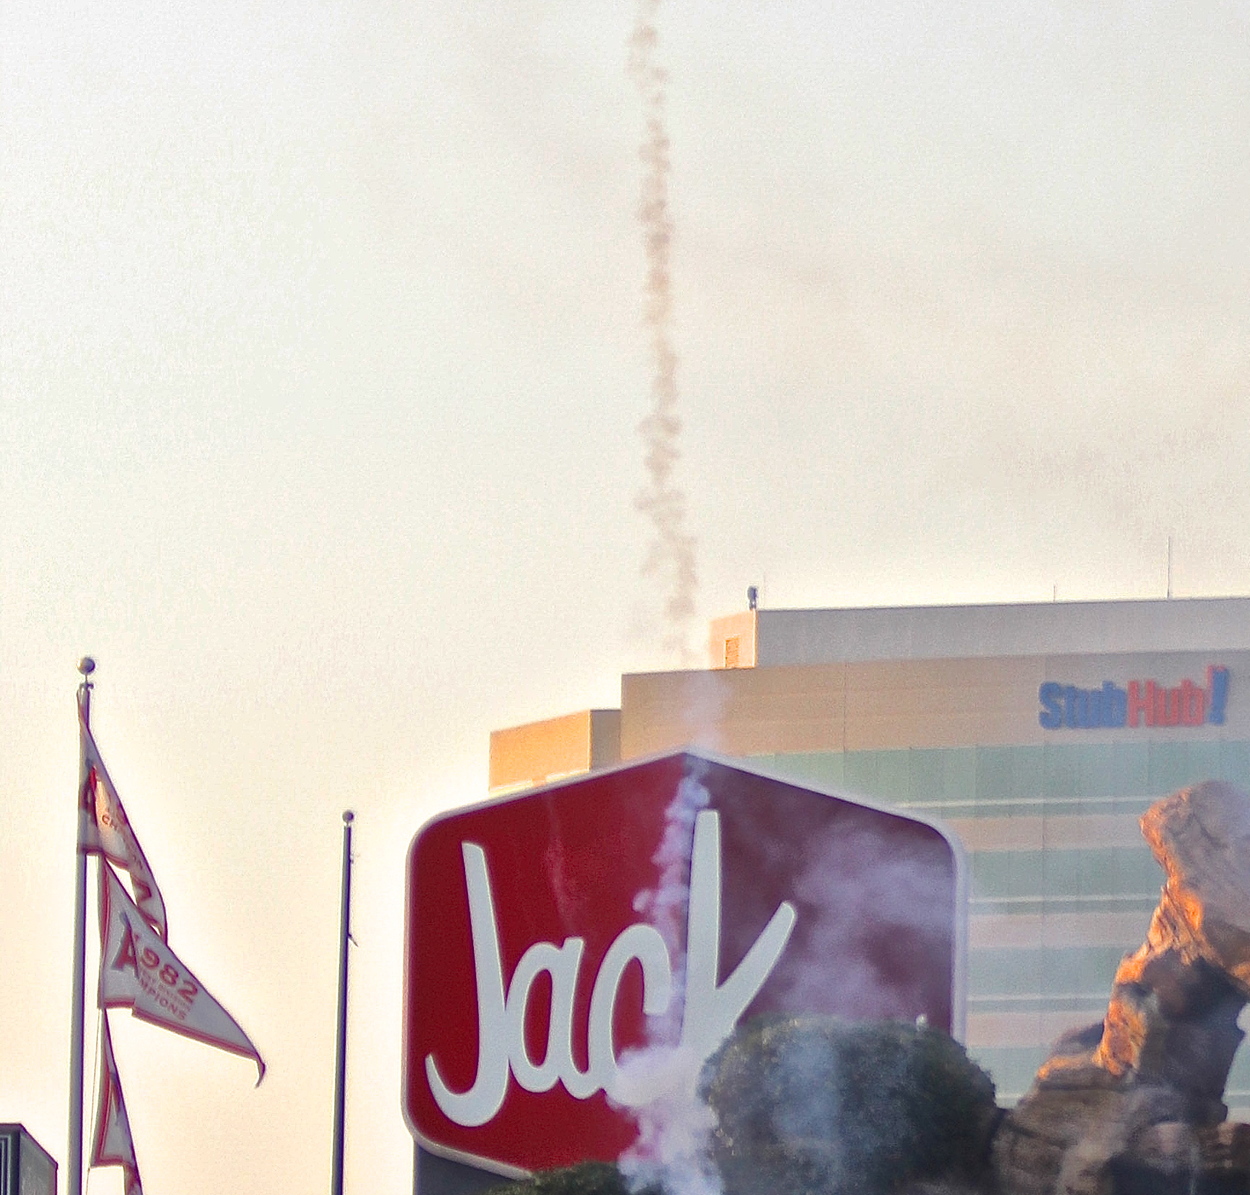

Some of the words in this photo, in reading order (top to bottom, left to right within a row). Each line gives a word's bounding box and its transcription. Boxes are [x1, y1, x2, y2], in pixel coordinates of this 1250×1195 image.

[1039, 664, 1229, 730] StubHub!
[136, 933, 198, 1004] 982
[139, 976, 188, 1021] MPIONS
[425, 809, 796, 1127] Jack
